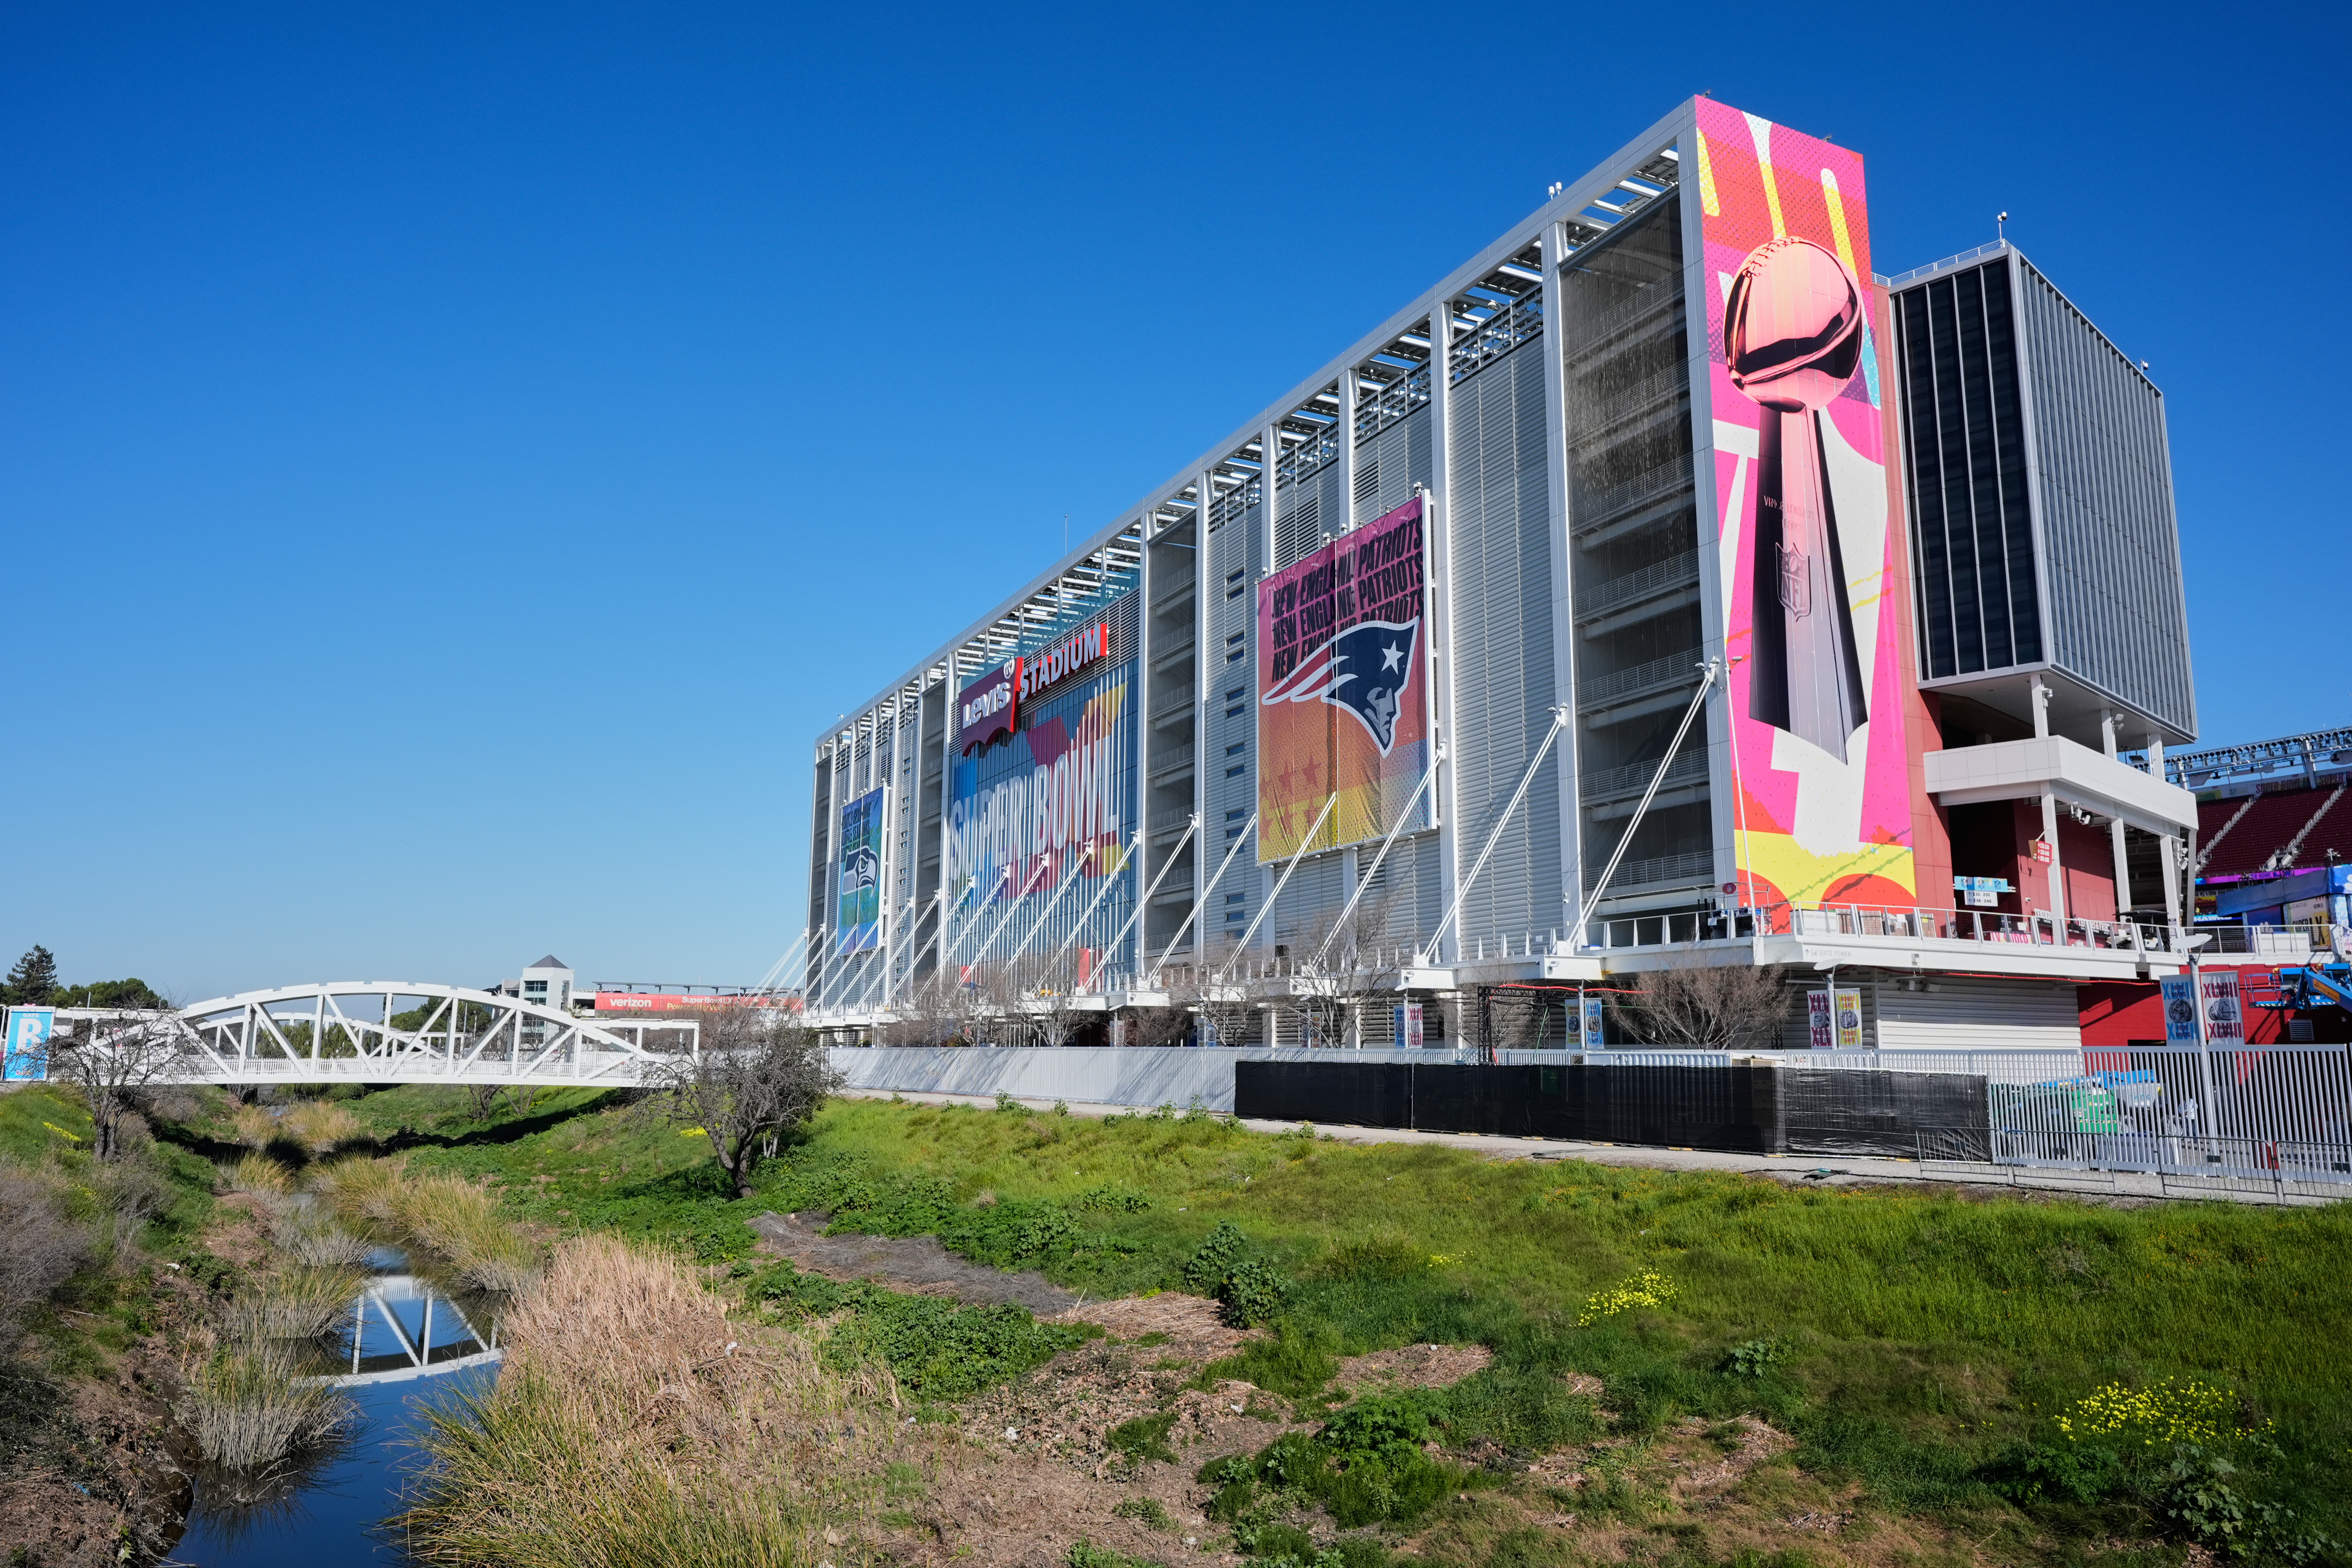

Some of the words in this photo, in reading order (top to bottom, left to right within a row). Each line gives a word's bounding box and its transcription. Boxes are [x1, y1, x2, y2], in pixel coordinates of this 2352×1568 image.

[1273, 579, 1298, 618] NEW
[1299, 550, 1355, 607] ENGLAND
[1358, 514, 1423, 578] PATRIOTS
[1782, 573, 1806, 609] NFL
[1273, 611, 1297, 650] NEW
[1299, 586, 1356, 637] ENGLAND
[1357, 551, 1424, 611] PATRIOTS
[1019, 623, 1105, 700] STADIUM
[1272, 642, 1299, 683] NEW
[950, 776, 1024, 881] SUPER
[1032, 735, 1117, 855] BOWL
[610, 997, 651, 1008] verizon
[682, 996, 704, 1004] Super
